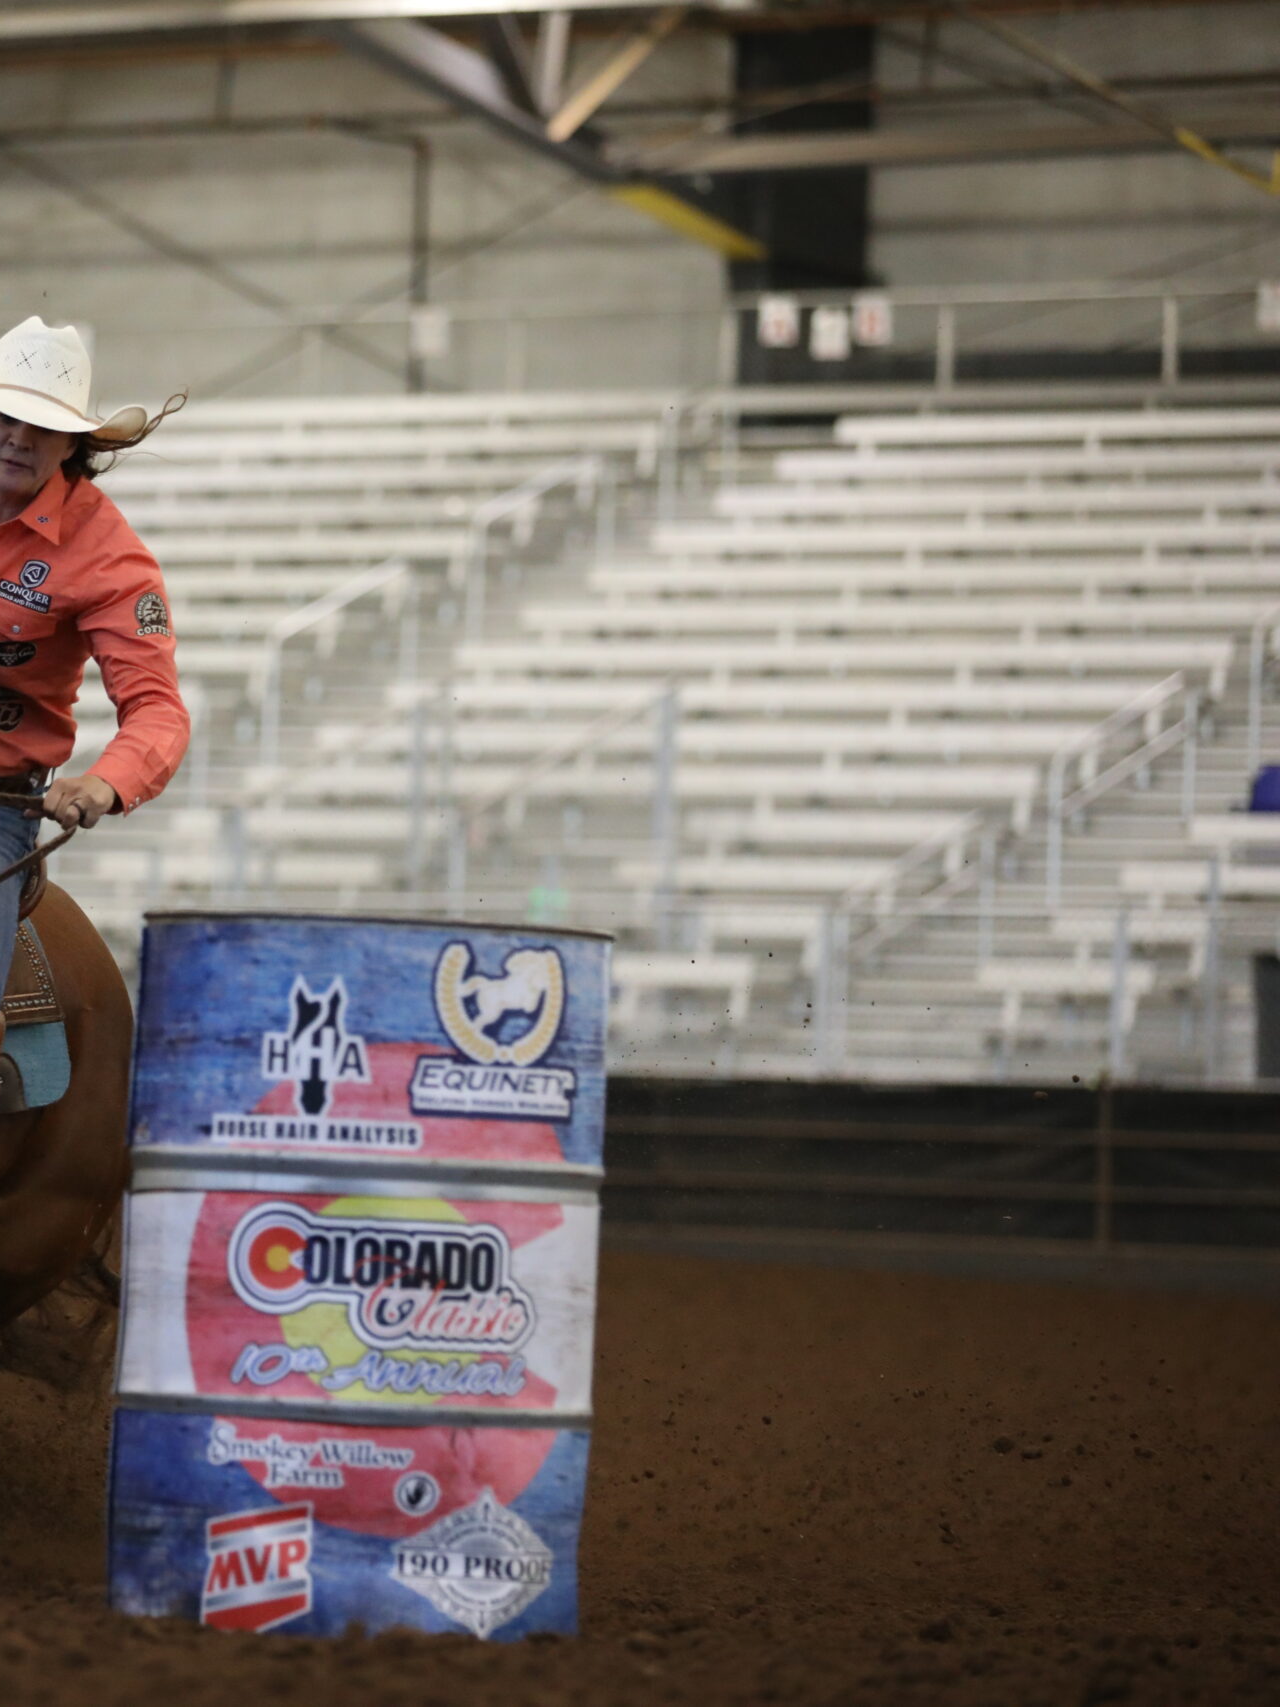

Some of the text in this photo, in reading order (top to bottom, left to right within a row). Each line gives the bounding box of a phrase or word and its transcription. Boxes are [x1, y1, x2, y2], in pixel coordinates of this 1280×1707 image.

[0, 581, 49, 605] CONQUER
[420, 1064, 569, 1097] EQUINETY
[217, 1120, 419, 1146] HORSE HAIR ANALYSIS
[248, 1226, 495, 1293] COLORADO
[323, 1349, 526, 1396] Annual
[210, 1424, 411, 1467] Smokey Willow
[270, 1462, 340, 1485] Farm
[207, 1539, 308, 1593] MVP
[397, 1552, 552, 1586] 190 PROOF
